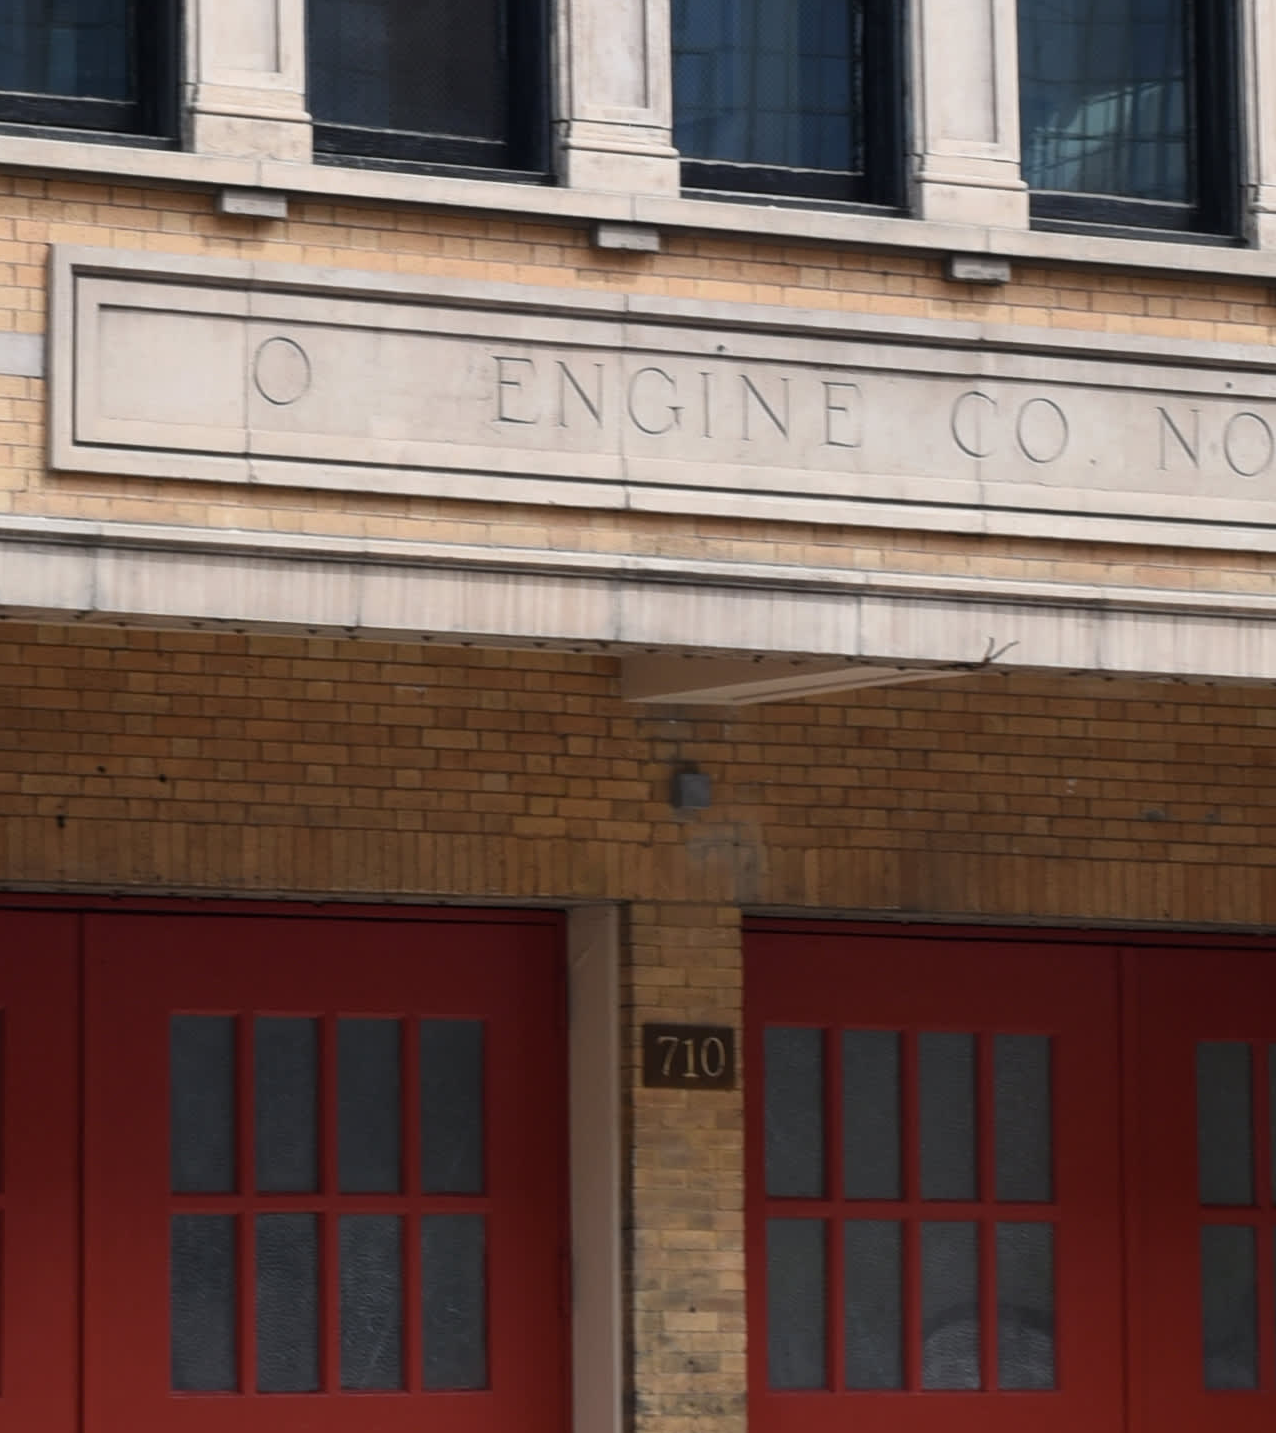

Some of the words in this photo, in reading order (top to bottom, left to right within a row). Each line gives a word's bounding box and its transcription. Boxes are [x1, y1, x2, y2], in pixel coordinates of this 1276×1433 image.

[489, 353, 865, 450] ENGINE
[949, 388, 1098, 466] CO.
[656, 1035, 727, 1078] 710
